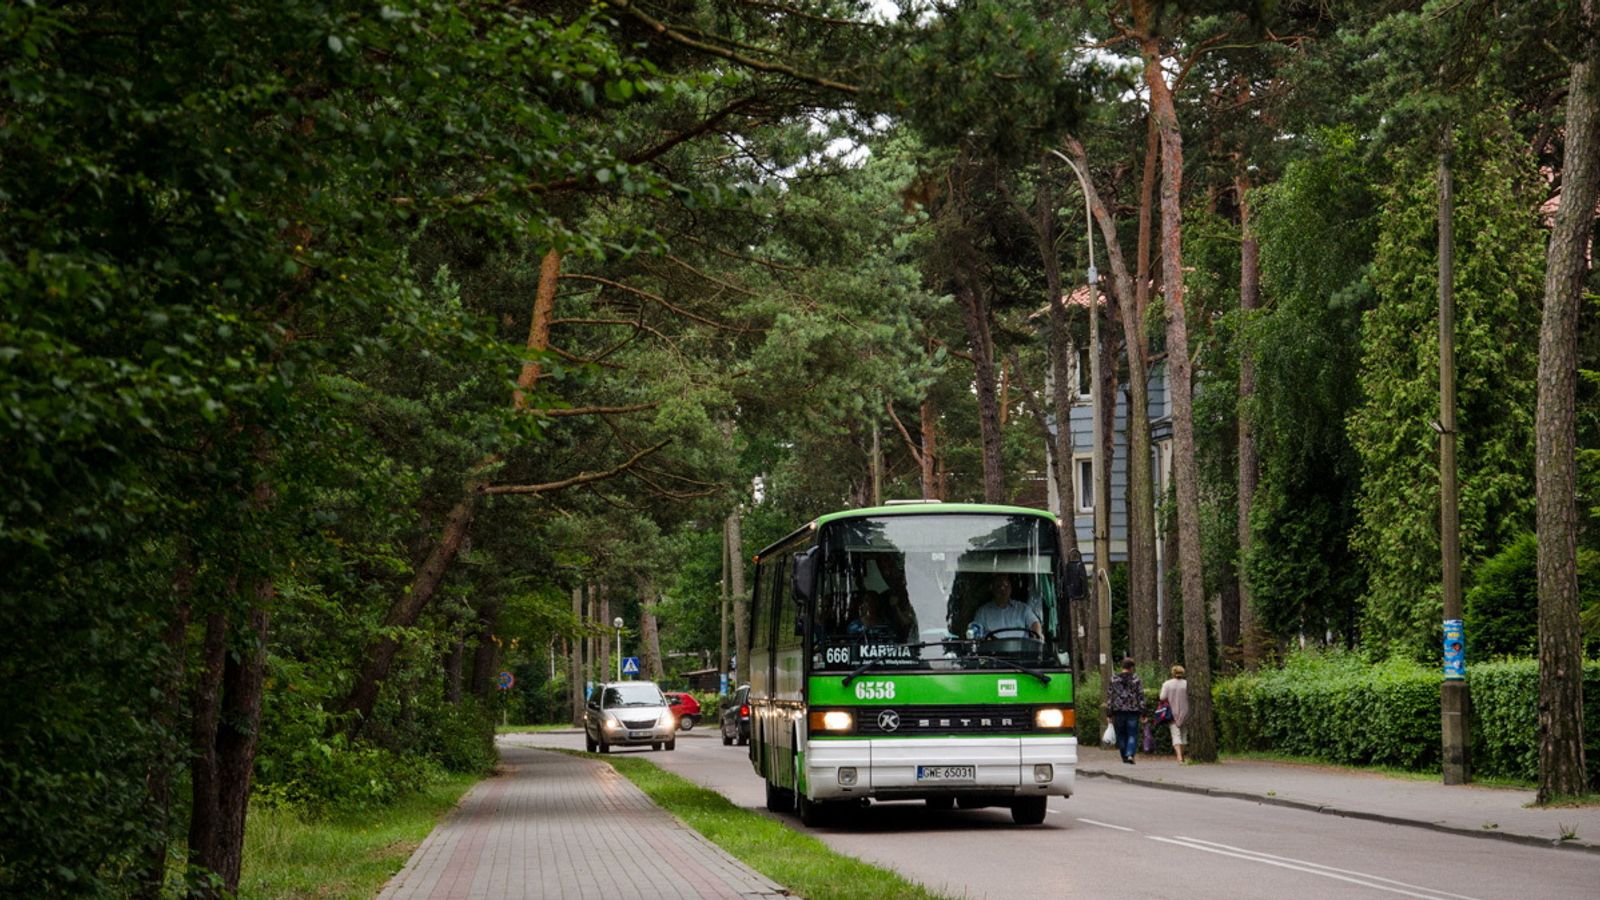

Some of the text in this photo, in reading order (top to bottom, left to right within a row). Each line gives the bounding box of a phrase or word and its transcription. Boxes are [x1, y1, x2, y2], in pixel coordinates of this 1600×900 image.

[826, 647, 848, 663] 666
[860, 644, 911, 657] KARWIA
[855, 681, 896, 700] 6558
[919, 718, 1013, 727] SETRA
[923, 767, 973, 778] GWE 65031
